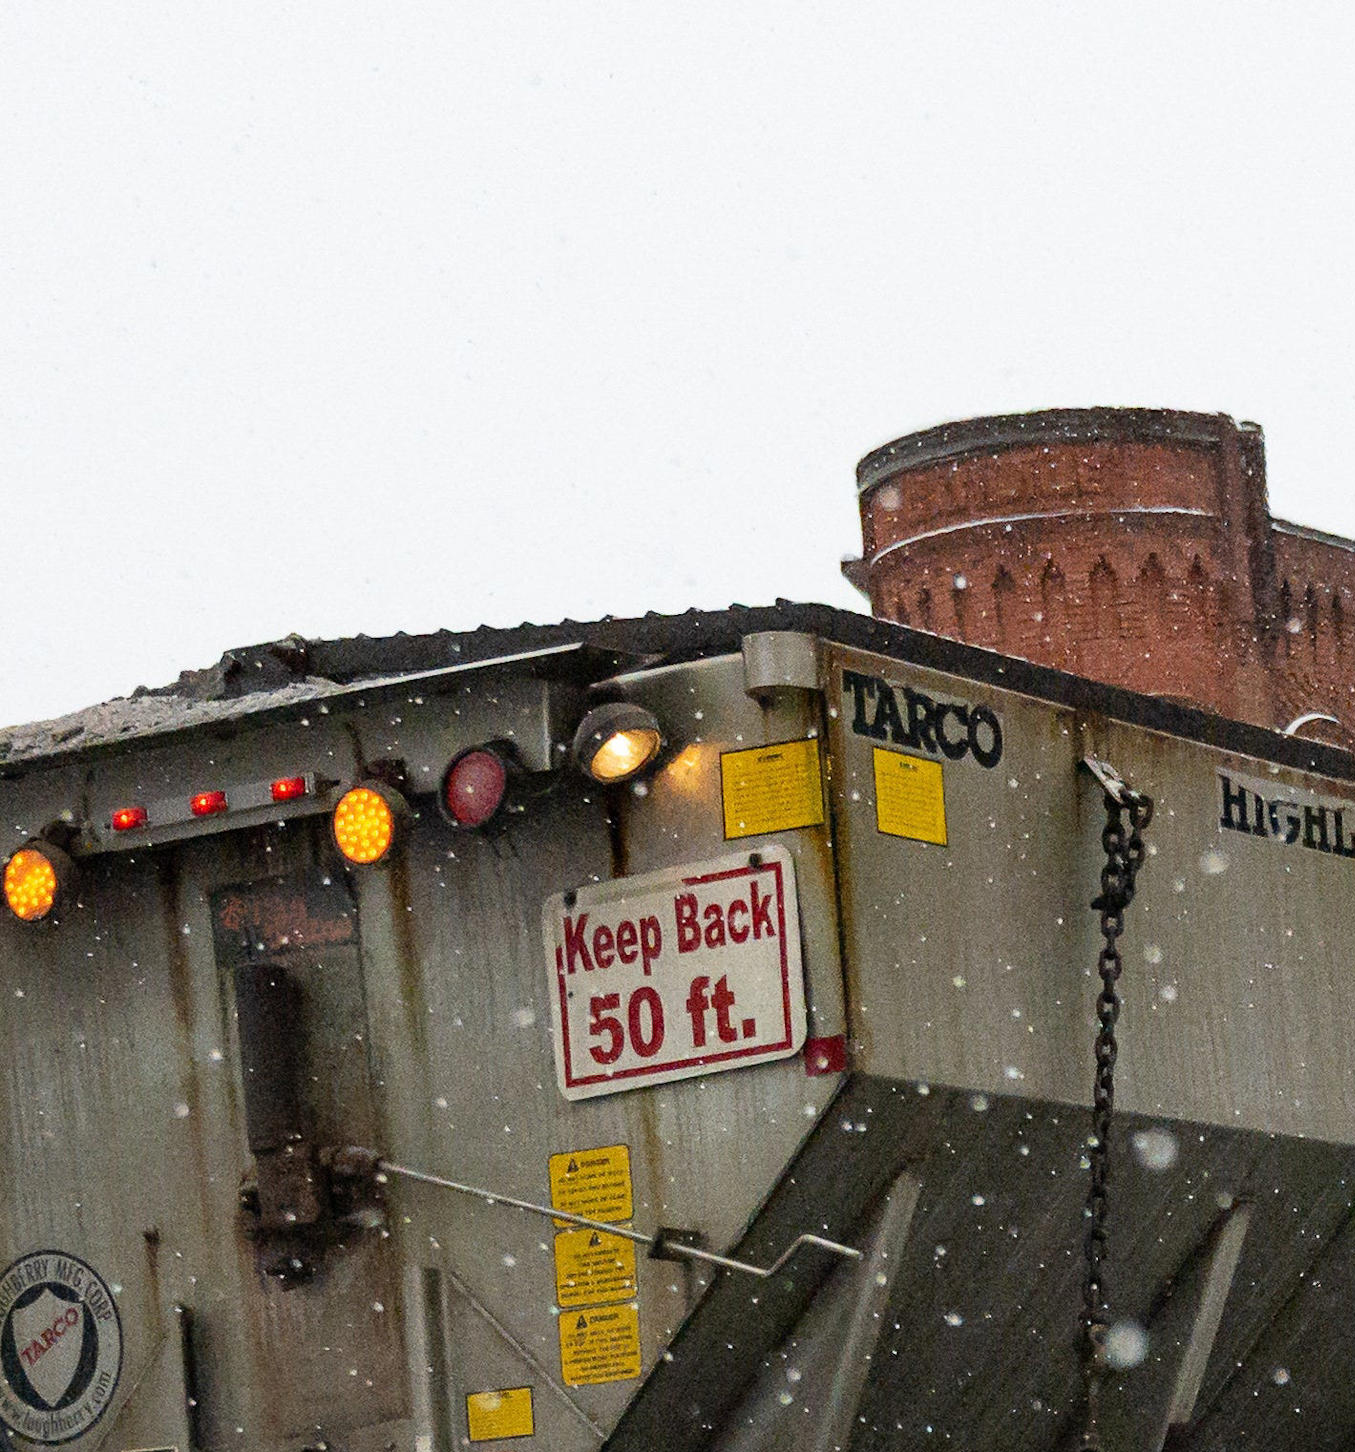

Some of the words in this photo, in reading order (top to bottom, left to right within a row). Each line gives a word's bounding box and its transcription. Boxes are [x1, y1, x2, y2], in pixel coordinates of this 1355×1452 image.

[842, 669, 1002, 769] TARCO
[563, 913, 662, 976] Keep
[674, 880, 776, 953] Back
[589, 986, 665, 1064] 50
[686, 974, 756, 1047] ft.
[21, 1307, 79, 1366] TARCO
